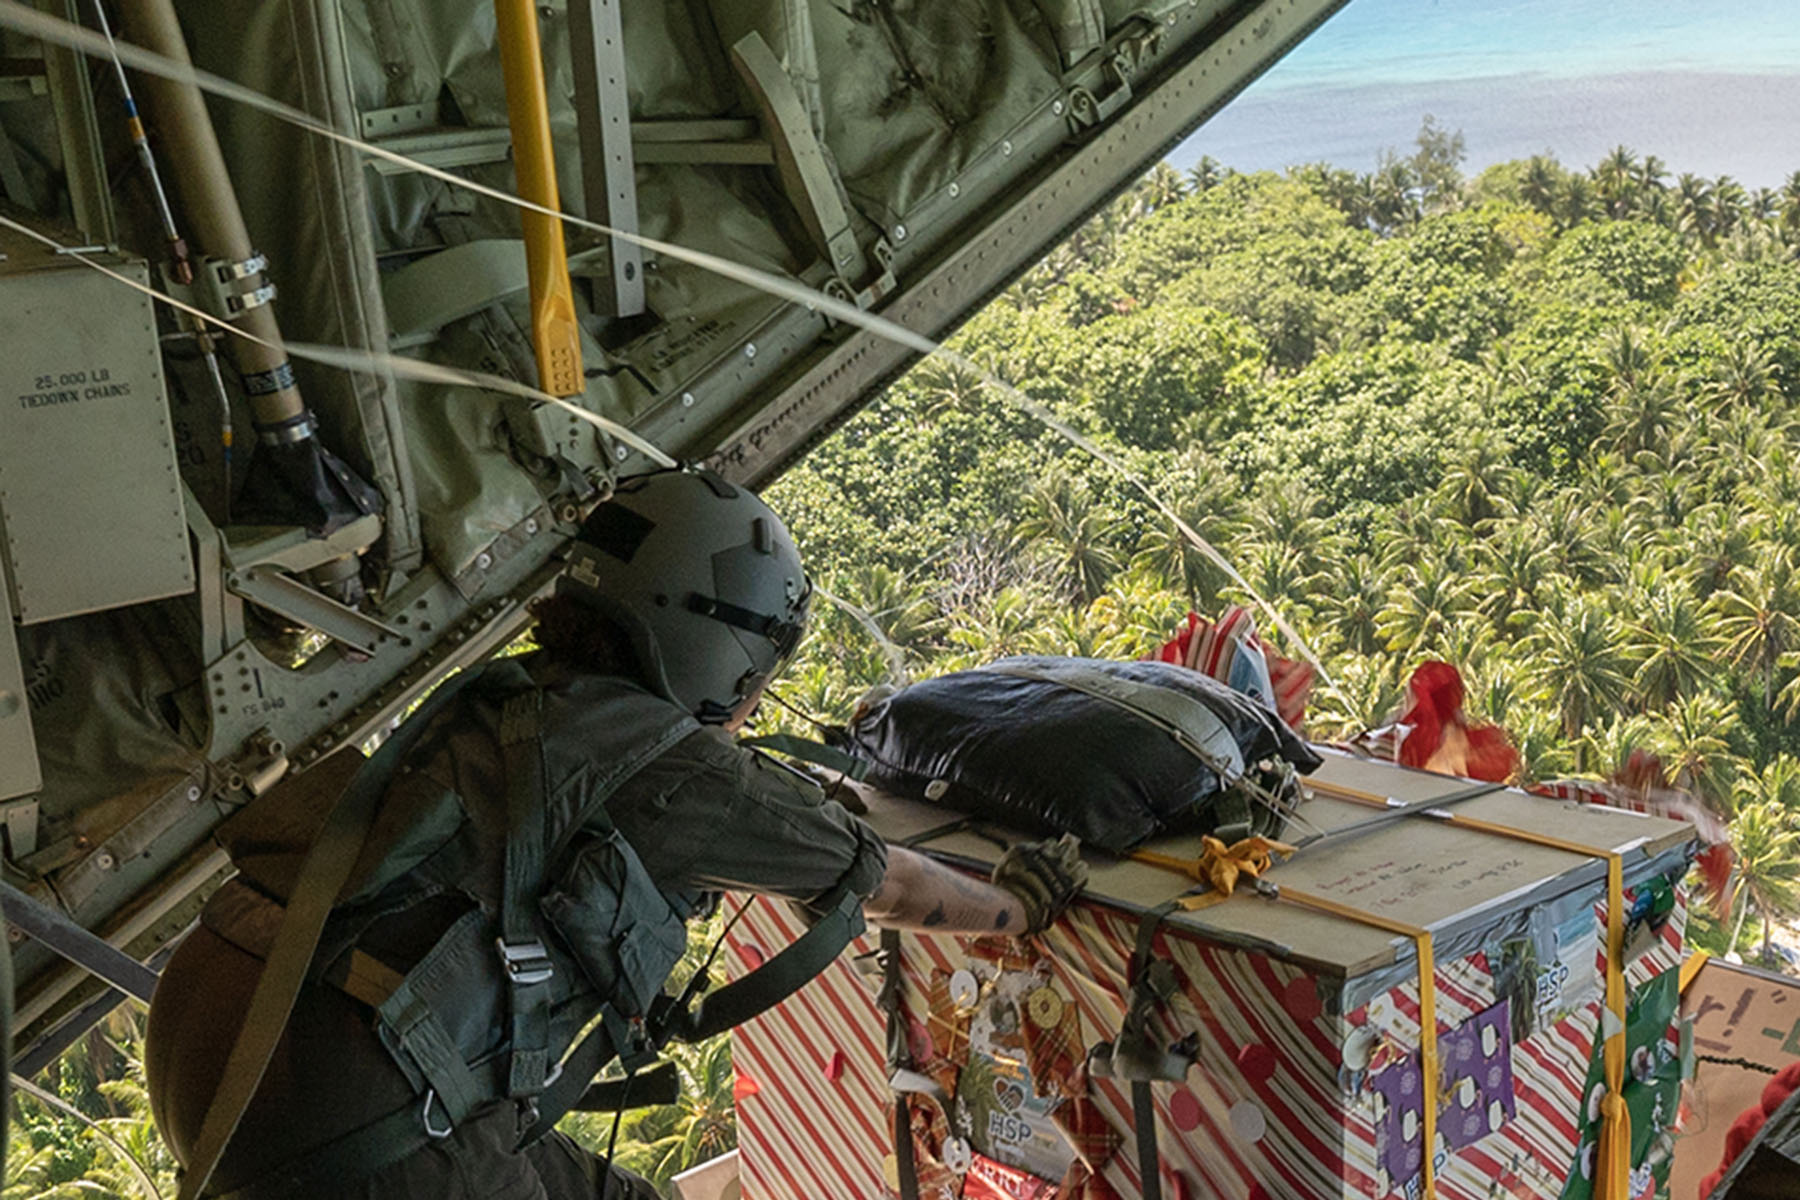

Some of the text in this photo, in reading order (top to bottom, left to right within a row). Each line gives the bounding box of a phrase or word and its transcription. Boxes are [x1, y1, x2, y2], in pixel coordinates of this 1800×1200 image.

[91, 368, 110, 383] LB
[19, 382, 130, 409] TIEDOWN CHAINS
[1539, 966, 1569, 1002] HSP
[990, 1112, 1032, 1141] HSP
